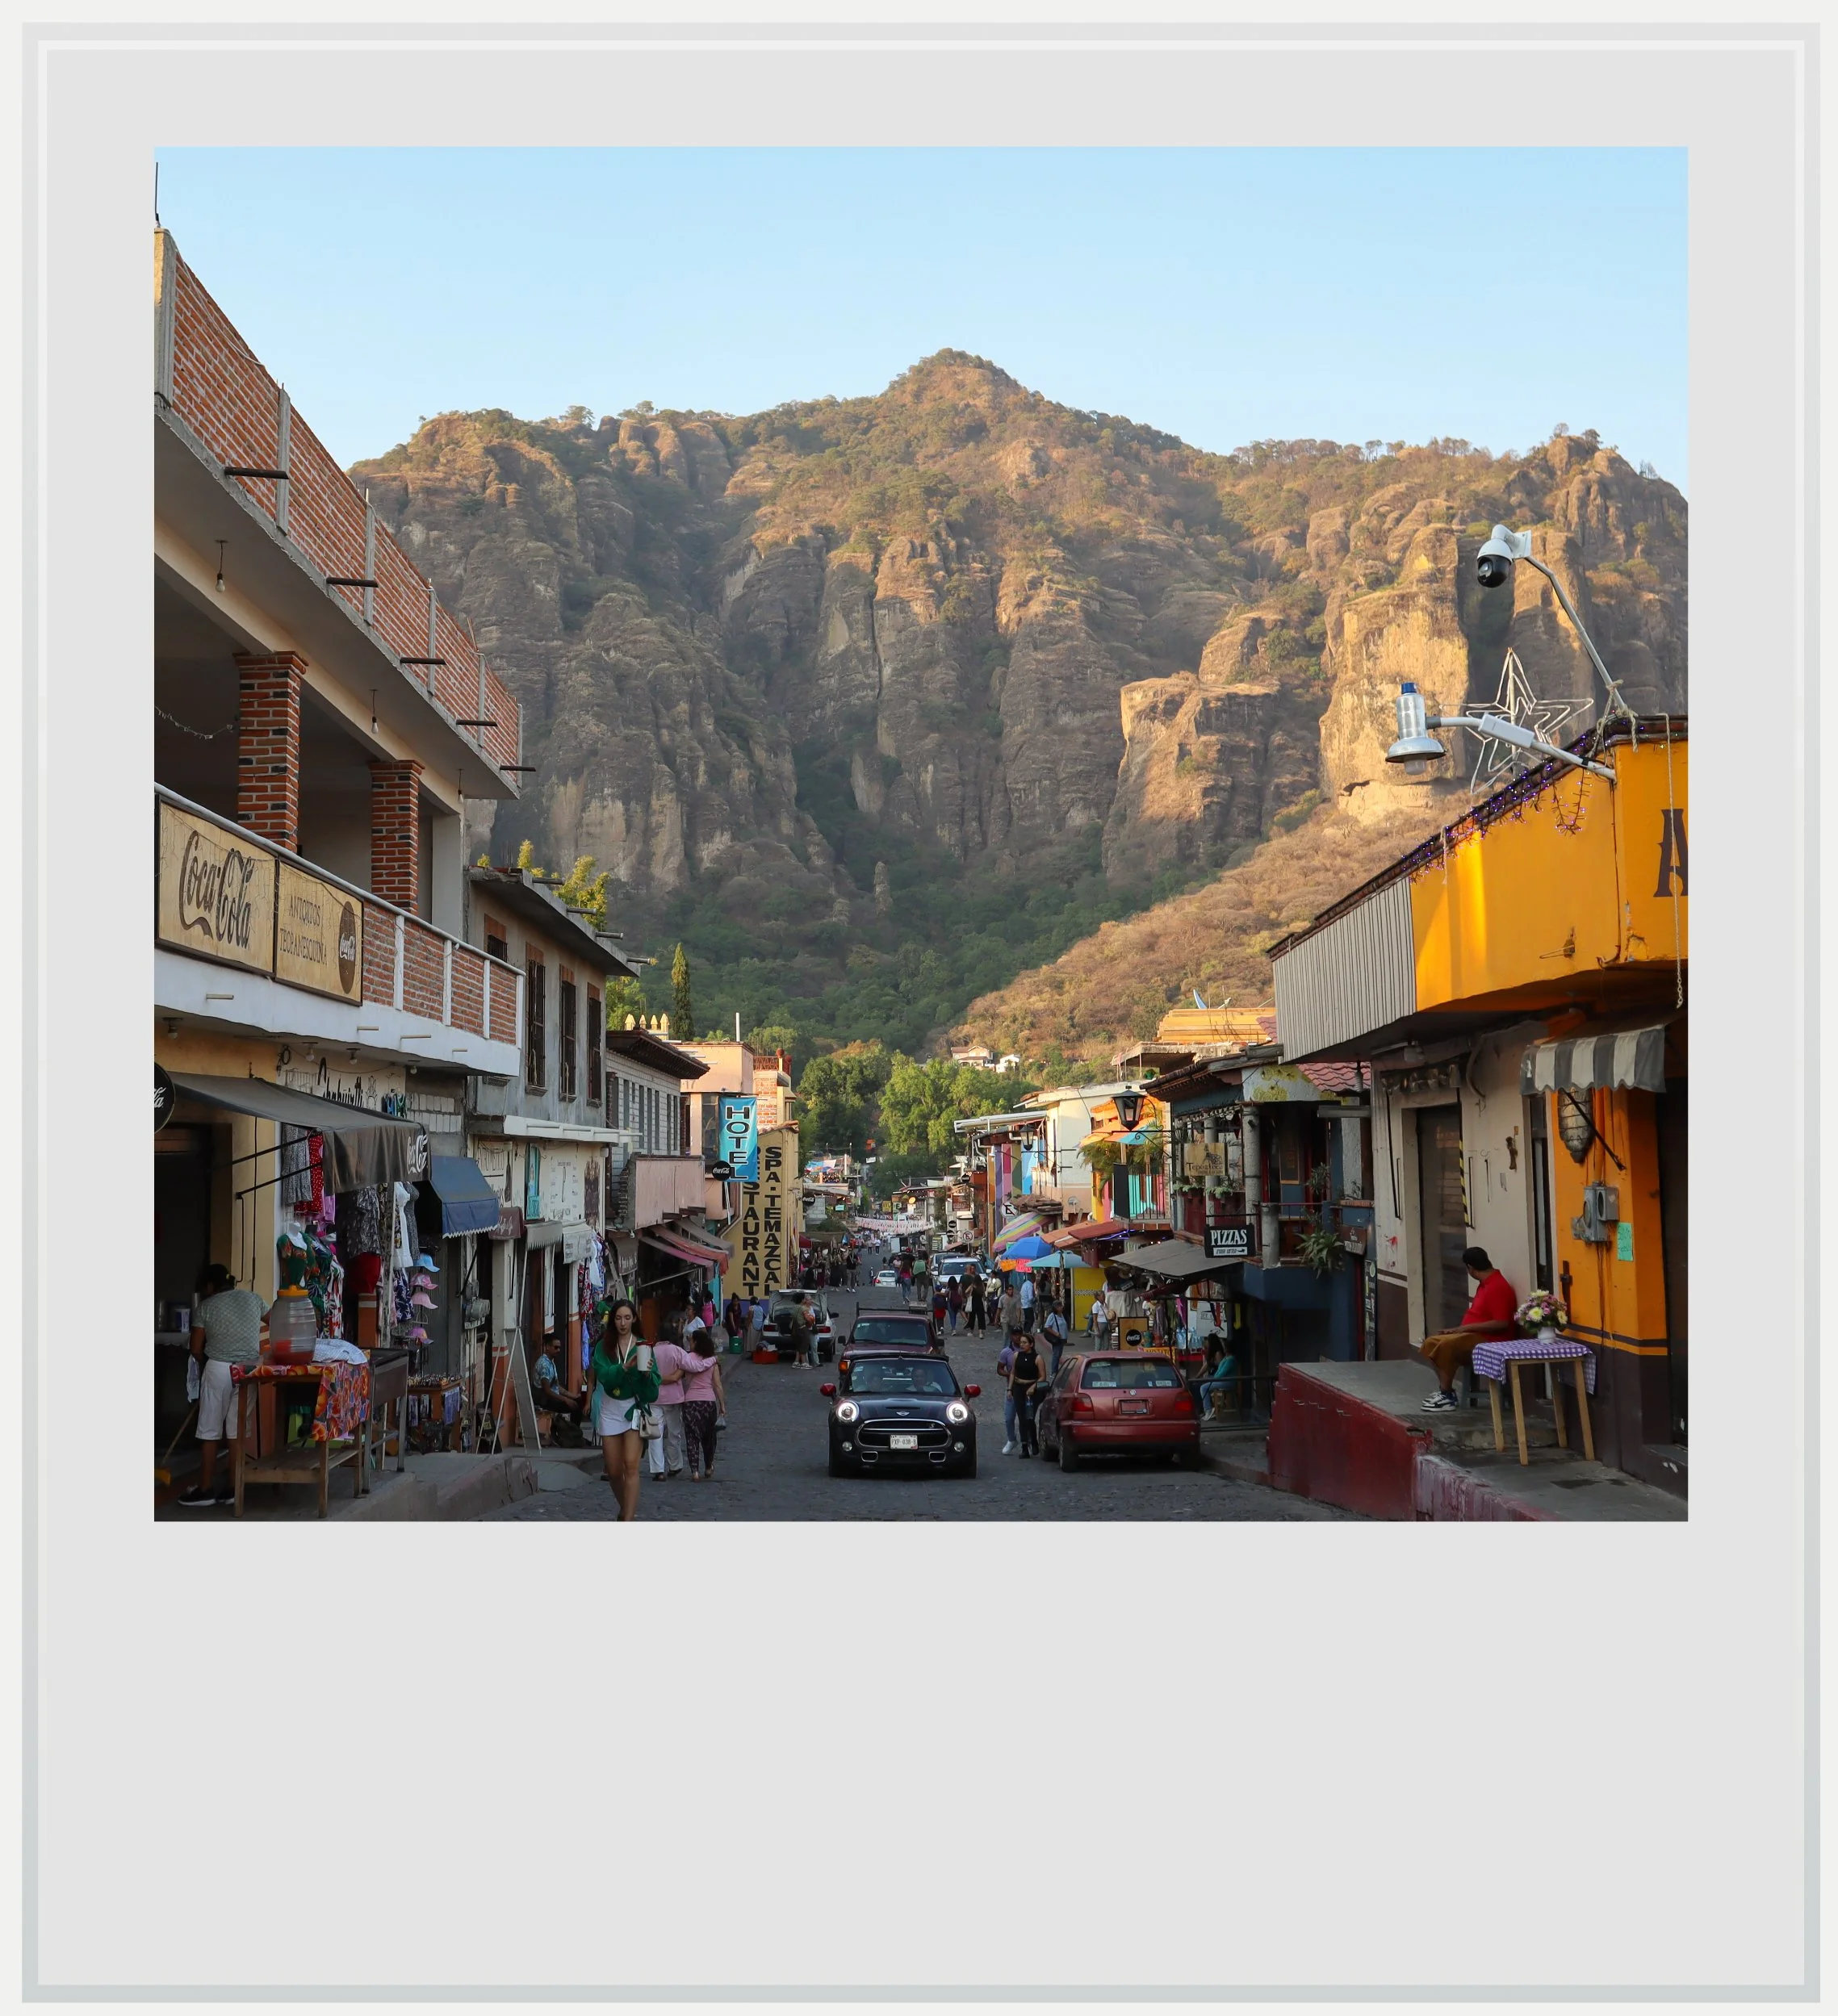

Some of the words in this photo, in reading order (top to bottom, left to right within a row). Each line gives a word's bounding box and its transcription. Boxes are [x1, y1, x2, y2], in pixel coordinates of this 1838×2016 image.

[726, 1106, 750, 1180] HOTEL
[743, 1146, 760, 1296] STAURANT
[1210, 1229, 1247, 1245] PIZZAS
